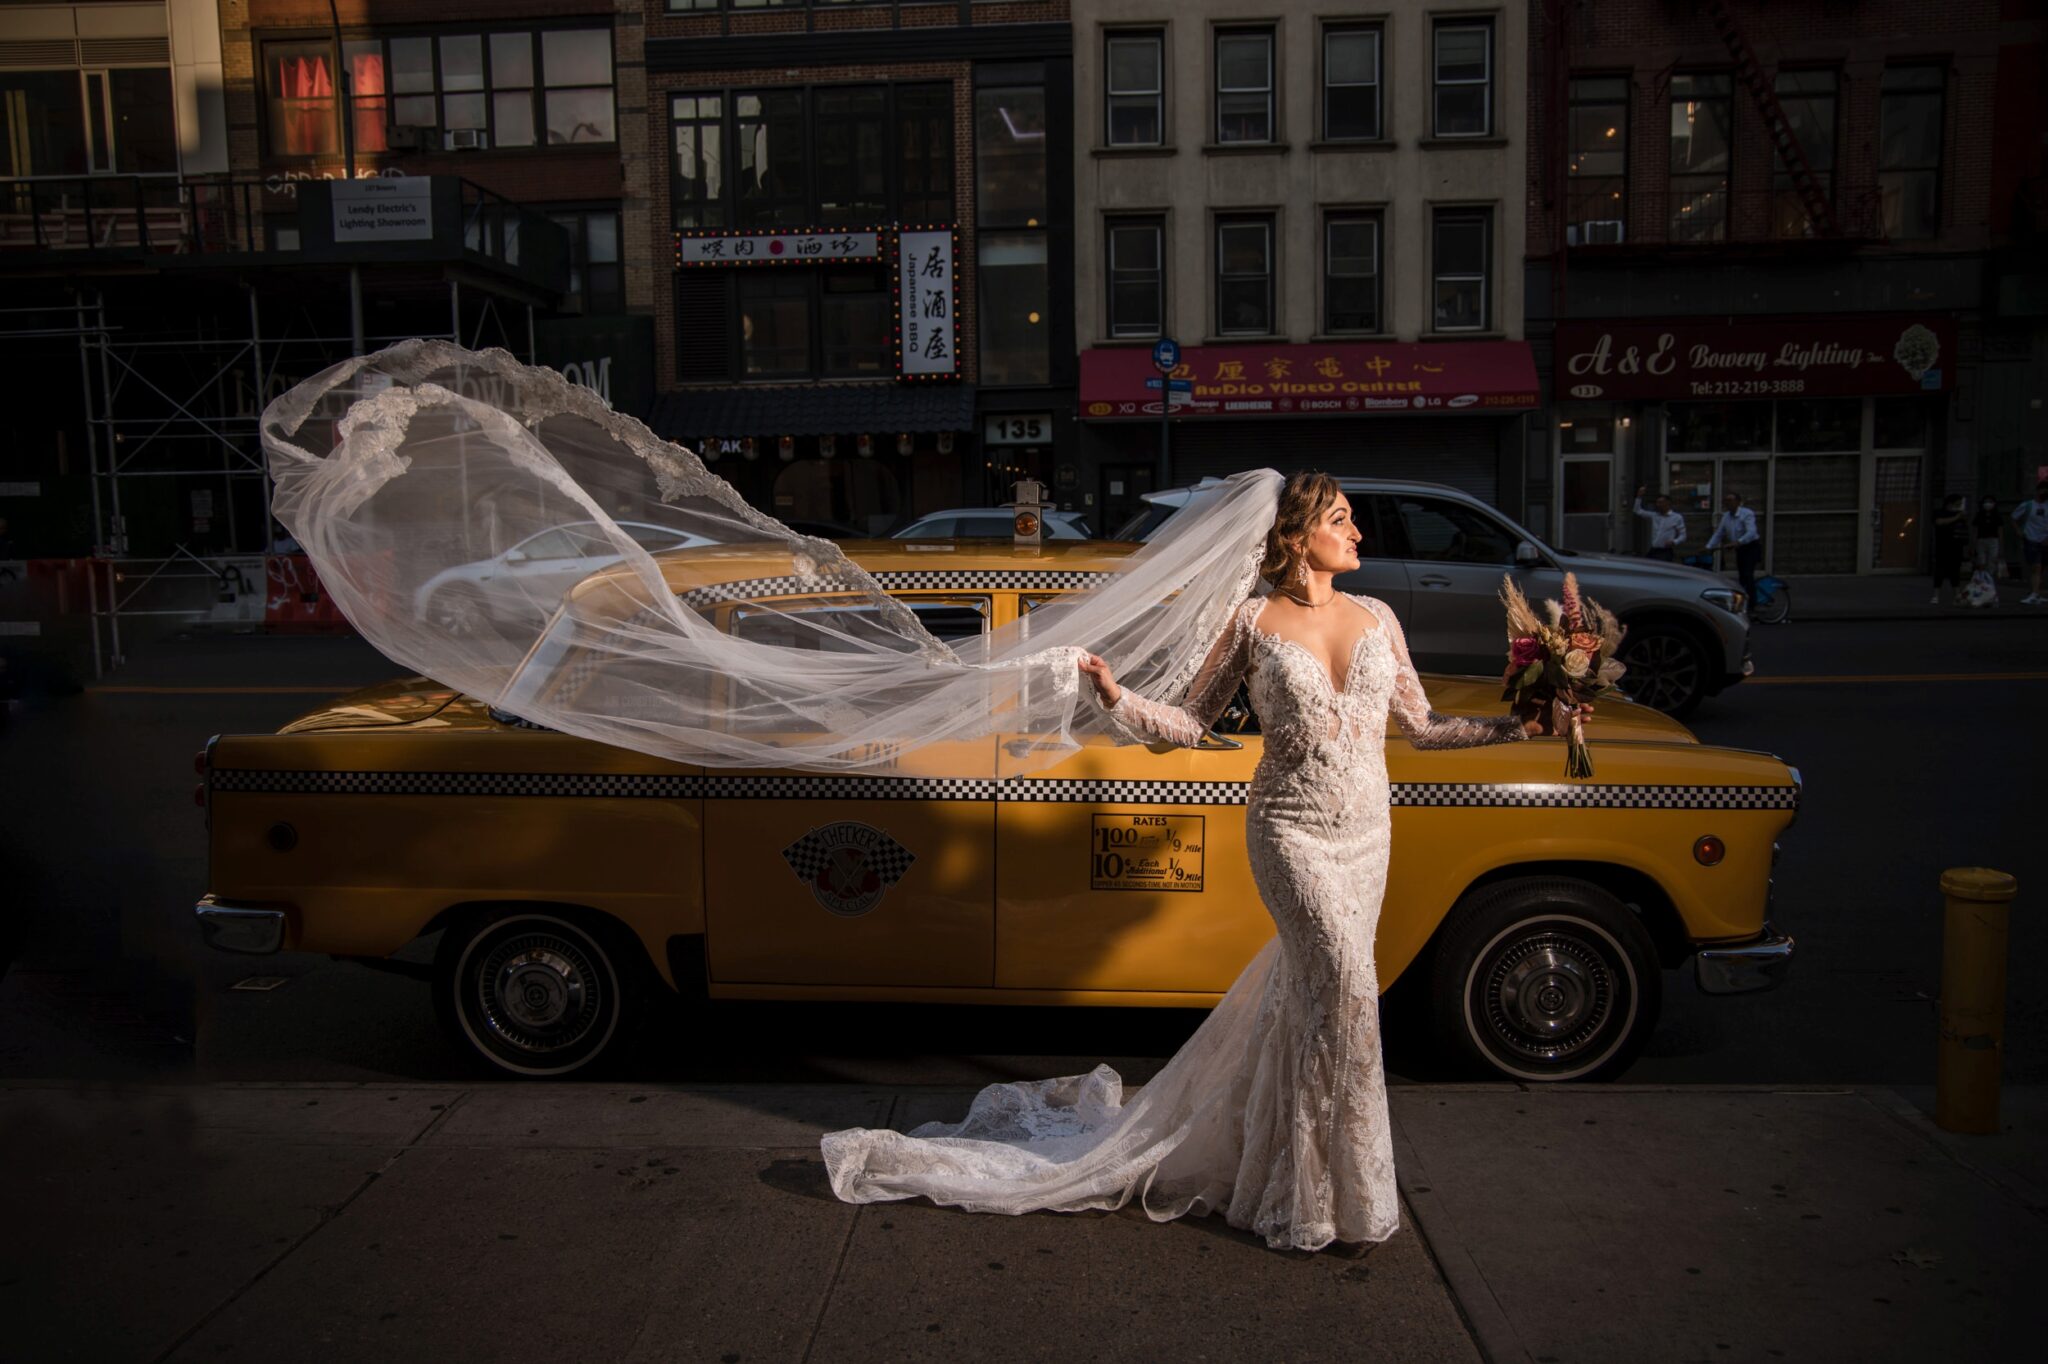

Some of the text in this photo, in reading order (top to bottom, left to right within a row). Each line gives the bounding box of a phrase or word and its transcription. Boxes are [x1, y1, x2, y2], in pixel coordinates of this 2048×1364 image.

[348, 204, 416, 215] Lendy Electric's
[340, 217, 426, 229] Lighting Showroom
[908, 253, 919, 353] Japanese BBQ
[922, 246, 949, 360] 居酒屋
[1567, 333, 1612, 375] A
[1617, 345, 1641, 375] &
[1645, 332, 1677, 375] E
[1688, 344, 1768, 372] Bowery
[1773, 341, 1865, 371] Lighting
[1577, 386, 1598, 397] 131
[1690, 380, 1805, 395] Tel: 212-219-3888
[1311, 400, 1342, 409] BOSCH
[1427, 398, 1441, 406] LG
[998, 419, 1041, 439] 135
[1133, 816, 1167, 826] RATES
[821, 825, 878, 850] CHECKER
[1184, 844, 1202, 853] Mile
[1126, 866, 1168, 875] Additional
[1138, 858, 1160, 867] Each
[1184, 873, 1202, 882] Mile
[825, 893, 873, 910] SPECIAL
